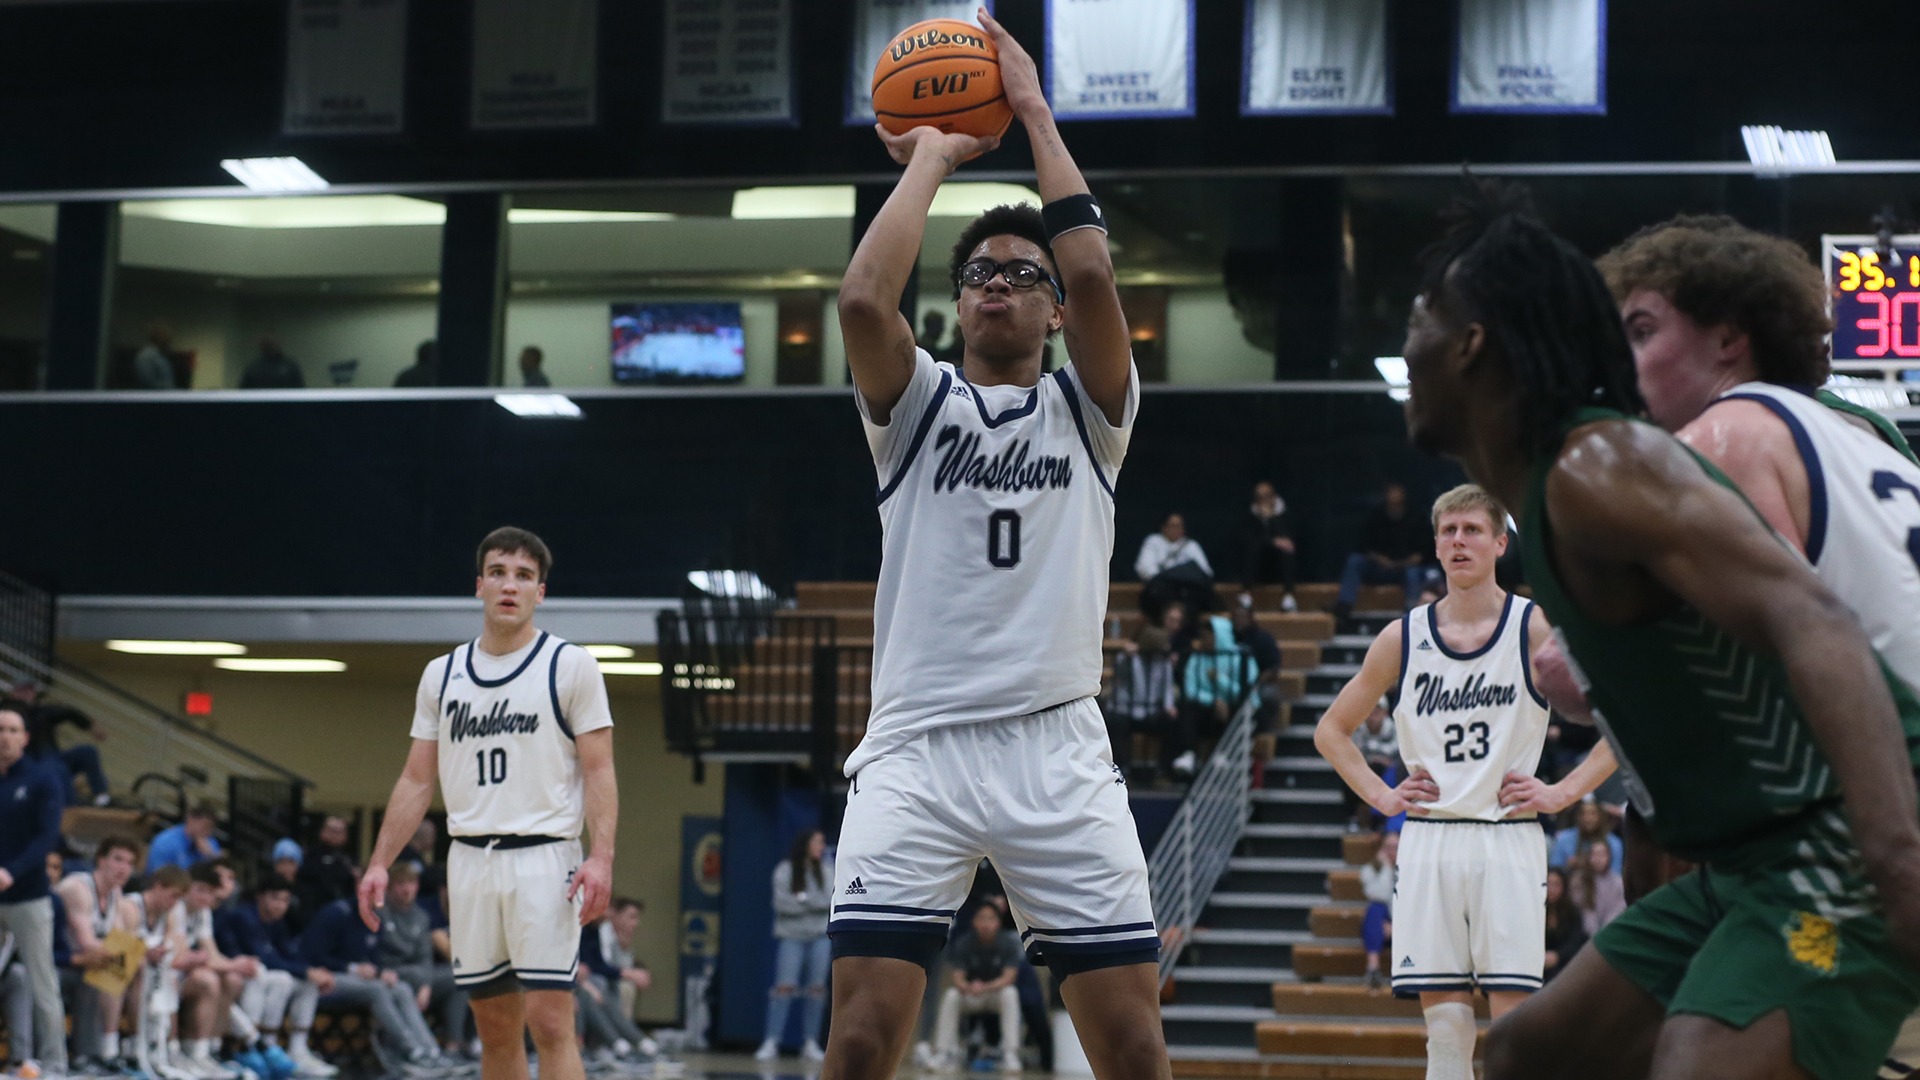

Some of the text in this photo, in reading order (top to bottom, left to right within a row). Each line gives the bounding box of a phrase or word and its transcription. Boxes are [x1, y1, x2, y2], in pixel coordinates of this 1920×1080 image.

[889, 29, 985, 62] Wilson
[912, 71, 970, 100] EVO
[1087, 73, 1152, 87] SWEET
[1288, 86, 1345, 100] EIGHT
[1292, 68, 1344, 83] ELITE
[1079, 90, 1159, 105] SIXTEEN
[1856, 291, 1920, 357] 30
[934, 424, 1073, 494] Washburn
[987, 508, 1021, 570] 0
[1415, 672, 1517, 717] Washburn
[446, 698, 539, 743] Washburn
[1444, 721, 1490, 763] 23
[476, 747, 507, 786] 10
